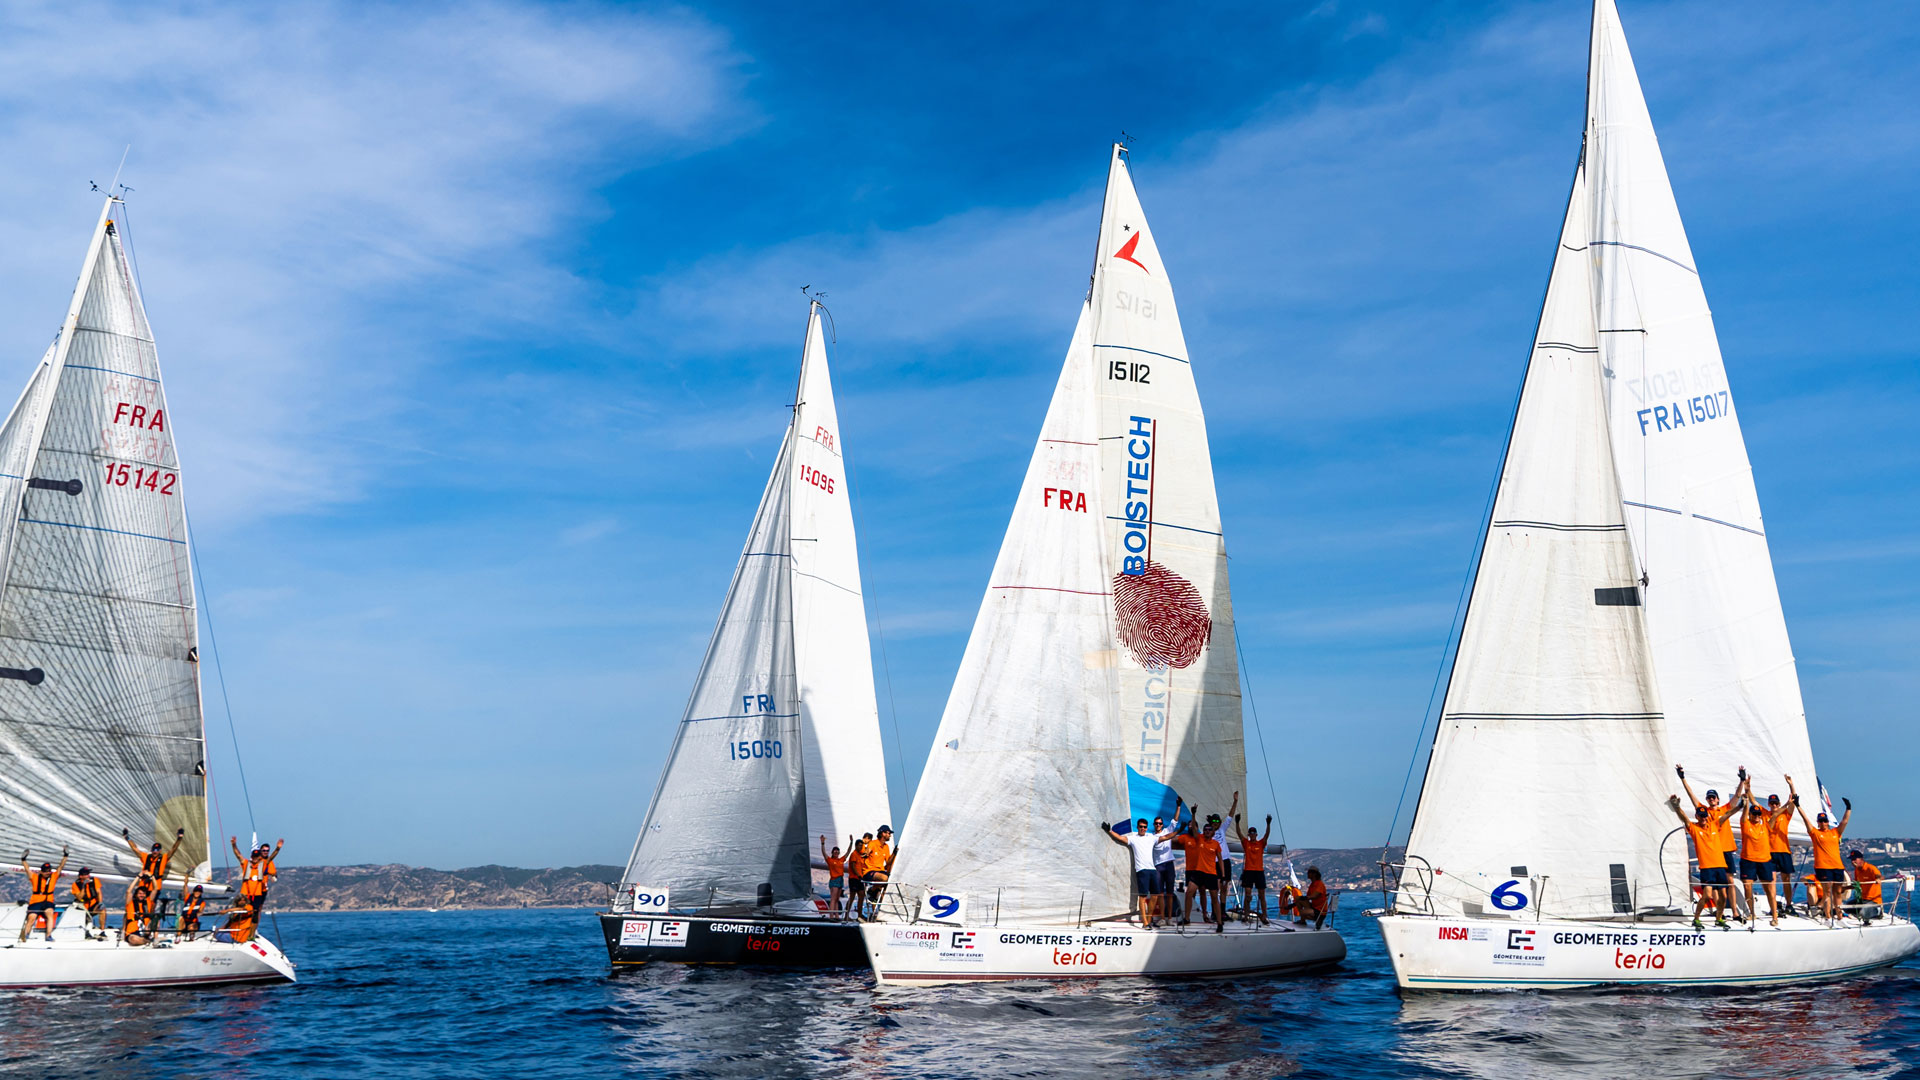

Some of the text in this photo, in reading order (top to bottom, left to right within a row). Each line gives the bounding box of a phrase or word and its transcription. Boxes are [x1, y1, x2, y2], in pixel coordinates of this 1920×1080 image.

[1109, 361, 1150, 384] 15112
[113, 402, 164, 432] FRA
[1637, 390, 1728, 437] FRA 15017
[815, 425, 834, 451] FRA
[105, 462, 176, 496] 15142
[800, 464, 835, 495] 15096
[1044, 487, 1088, 513] FRA
[1123, 415, 1151, 576] BOISTECH
[742, 694, 776, 713] FRA
[730, 740, 782, 760] 15050
[637, 893, 666, 907] 90
[1491, 880, 1528, 911] 6
[929, 894, 960, 918] 9
[624, 923, 648, 933] ESTP
[709, 923, 766, 935] GEOMETRES
[772, 926, 810, 936] EXPERTS
[893, 929, 940, 941] le cnam
[1438, 927, 1468, 941] INSA
[747, 935, 780, 951] teria
[918, 940, 938, 950] esgt
[1000, 934, 1073, 946] GEOMETRES
[1082, 936, 1133, 947] EXPERTS
[1553, 933, 1638, 946] GEOMETRES
[1650, 934, 1706, 946] EXPERTS
[1053, 947, 1097, 966] teria
[1615, 947, 1665, 969] teria
